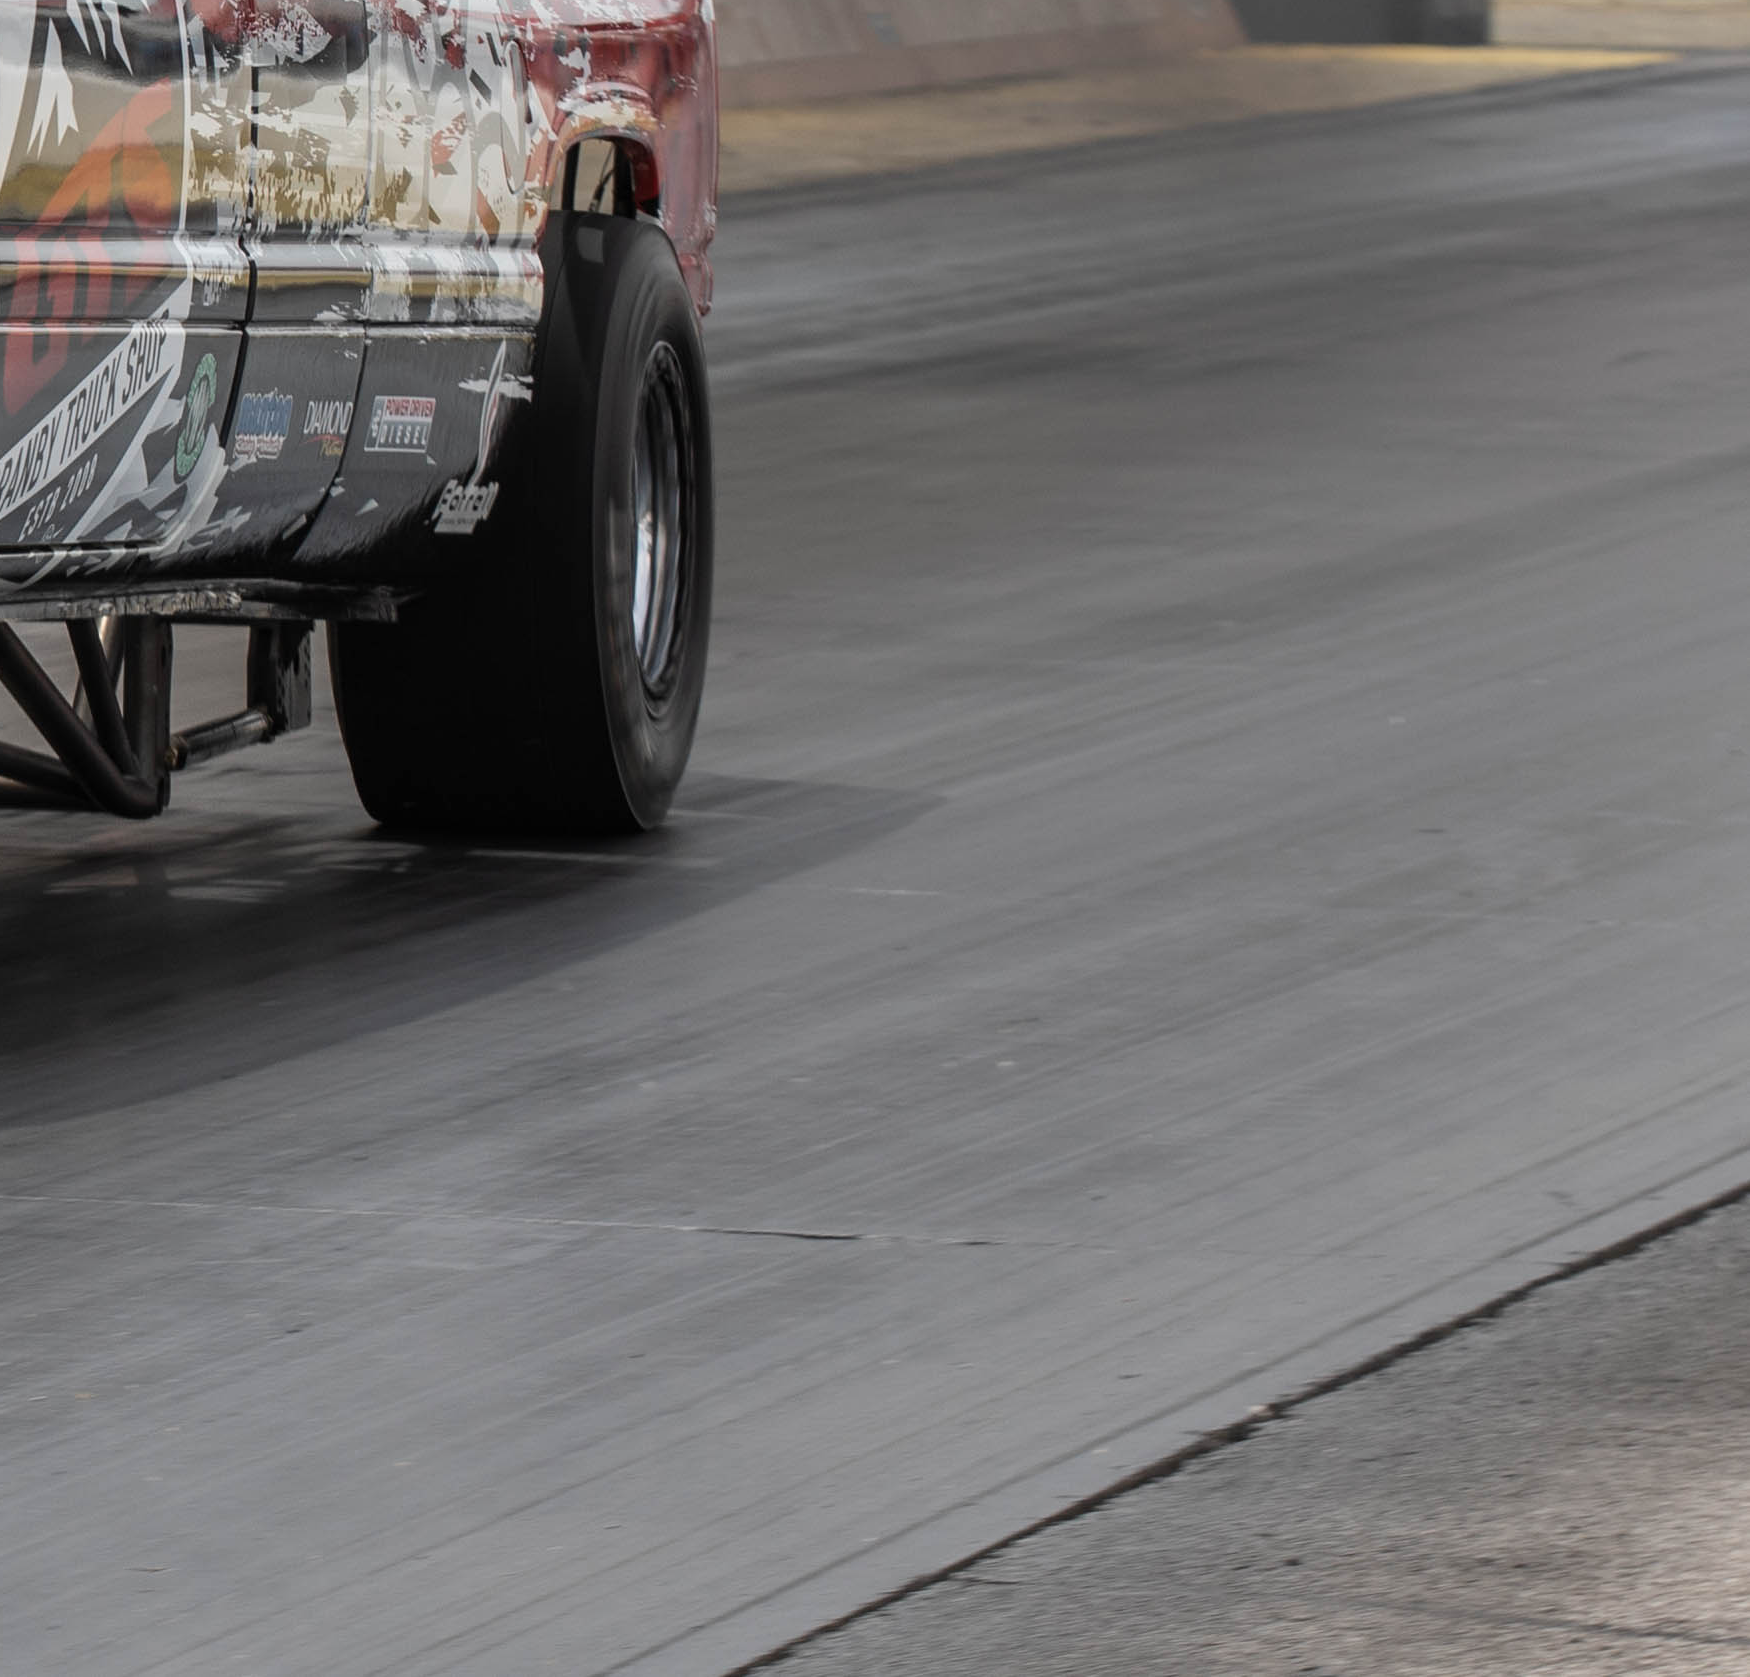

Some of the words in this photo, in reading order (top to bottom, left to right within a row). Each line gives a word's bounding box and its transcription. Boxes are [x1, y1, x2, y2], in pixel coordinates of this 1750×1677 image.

[59, 349, 124, 466] TRUCK
[121, 307, 170, 406] SHOP
[303, 399, 354, 435] DIAMOND
[379, 424, 428, 445] DIESEL
